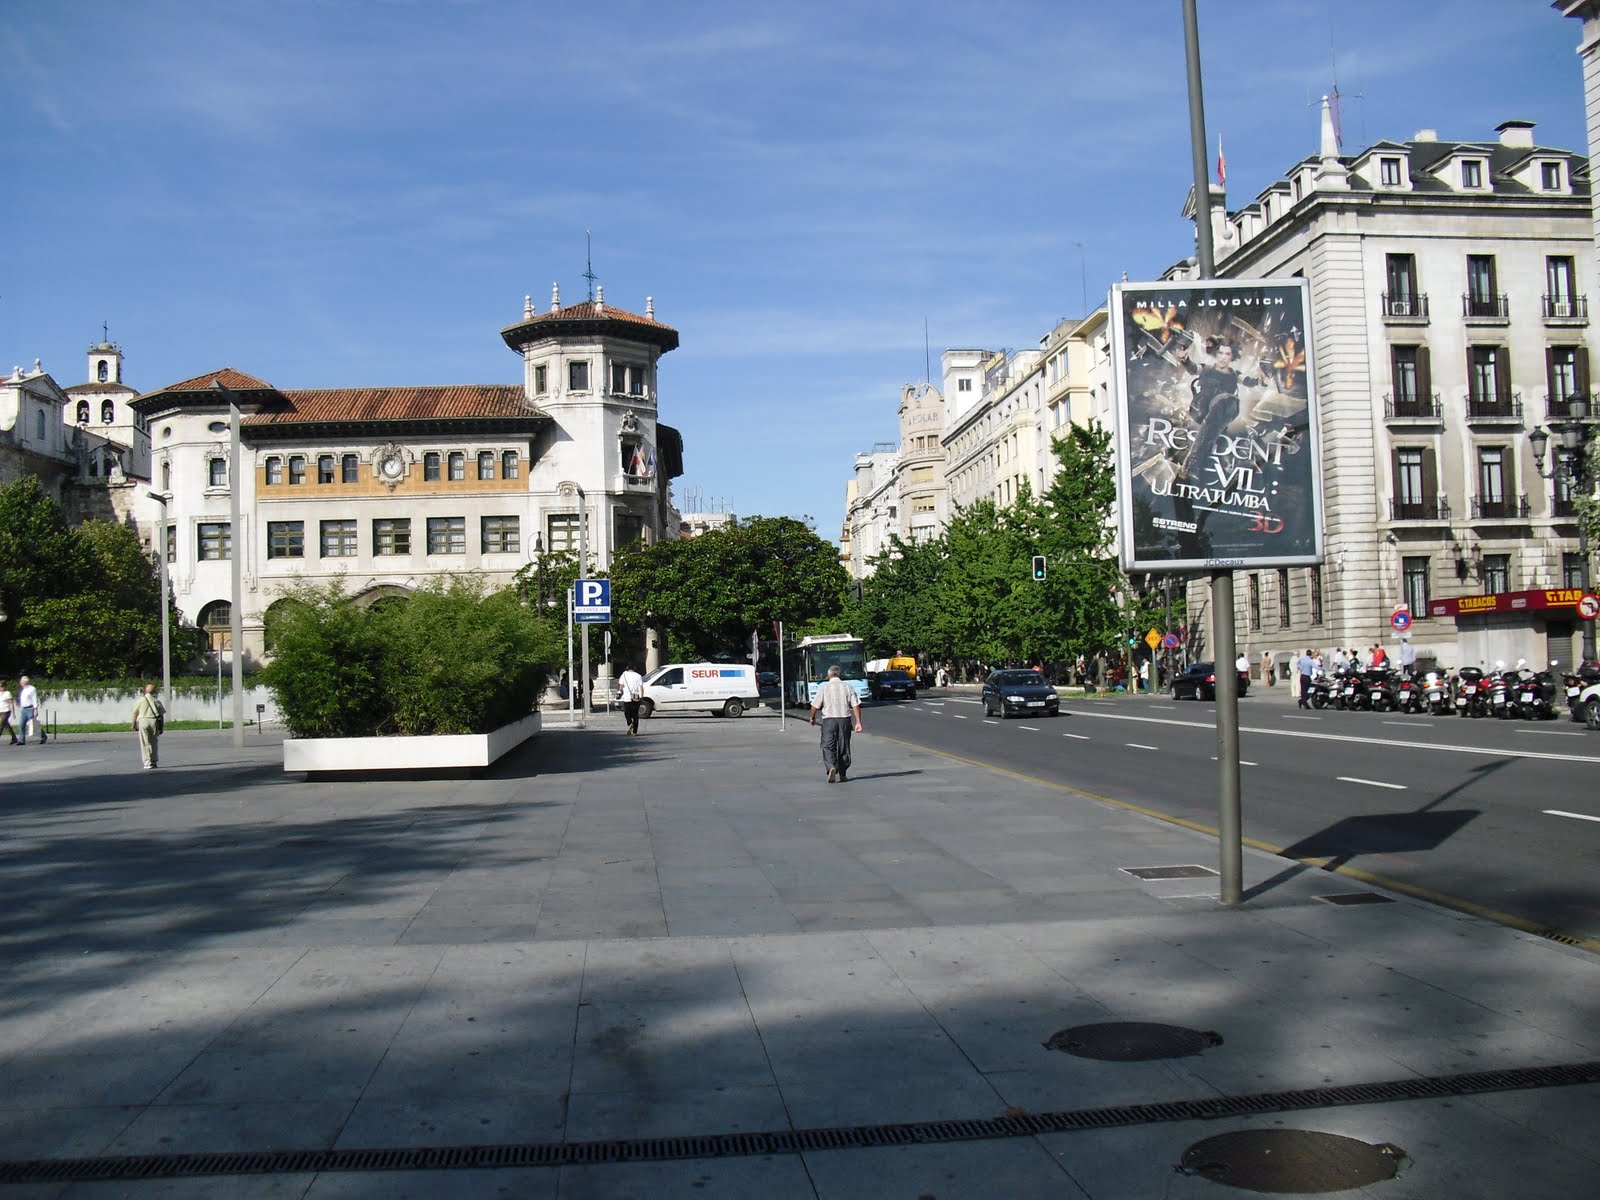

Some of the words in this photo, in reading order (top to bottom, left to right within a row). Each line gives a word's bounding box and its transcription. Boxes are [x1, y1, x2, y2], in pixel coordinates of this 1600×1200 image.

[1136, 300, 1187, 309] MILLA
[1197, 297, 1283, 307] JOVOVICH
[1144, 417, 1287, 466] RESDENT
[1151, 478, 1271, 512] ULTRATUMBA
[1152, 517, 1198, 530] ESTRENO
[1247, 510, 1285, 534] 3D
[1203, 558, 1244, 567] JCDecaux
[582, 581, 603, 606] P
[1465, 596, 1497, 608] TABACOS
[691, 669, 719, 679] SEUR
